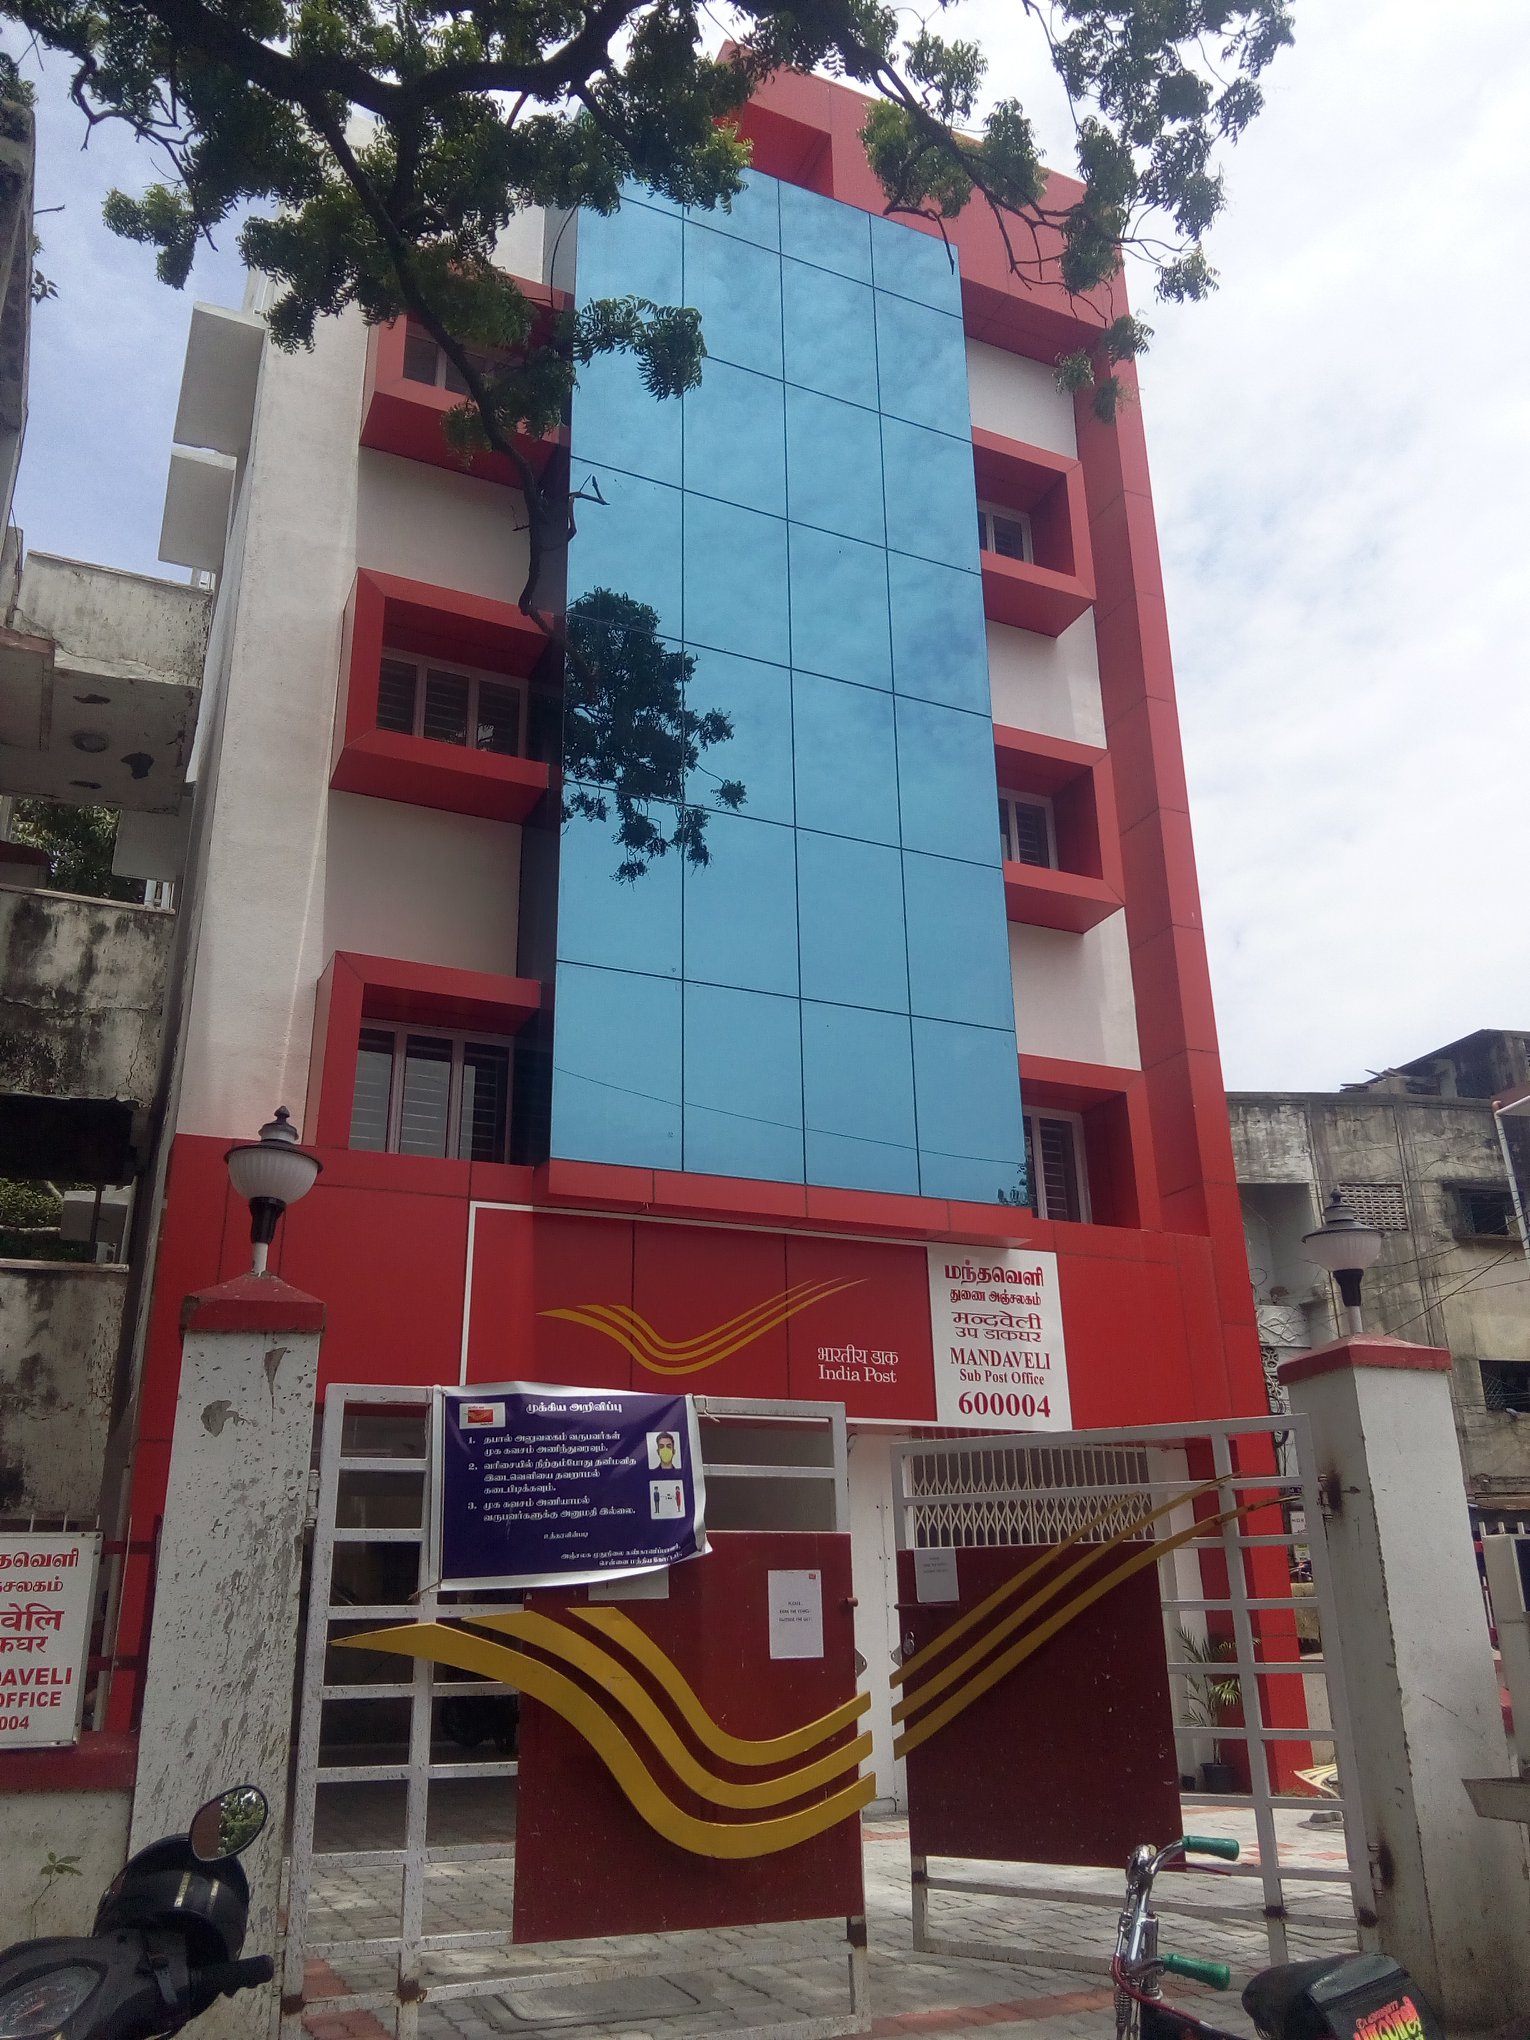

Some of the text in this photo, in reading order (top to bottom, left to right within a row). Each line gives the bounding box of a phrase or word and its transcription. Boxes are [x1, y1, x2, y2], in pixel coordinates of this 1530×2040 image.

[944, 1259, 1044, 1287] மந்தவெளி
[950, 1288, 1041, 1305] துணை அஞ்சலகம்
[951, 1310, 1043, 1330] मन्दवेली
[955, 1326, 1042, 1343] उप डाकघर
[817, 1344, 899, 1366] भारतीय डाक
[950, 1347, 1051, 1370] MANDAVELI
[818, 1364, 898, 1383] India Post
[959, 1368, 1045, 1385] Sub Post Office
[525, 1400, 622, 1414] முக்கிய அறிவிப்பு
[958, 1391, 1051, 1418] 600004
[0, 1576, 64, 1592] சலகம்
[0, 1667, 72, 1686] AVELI
